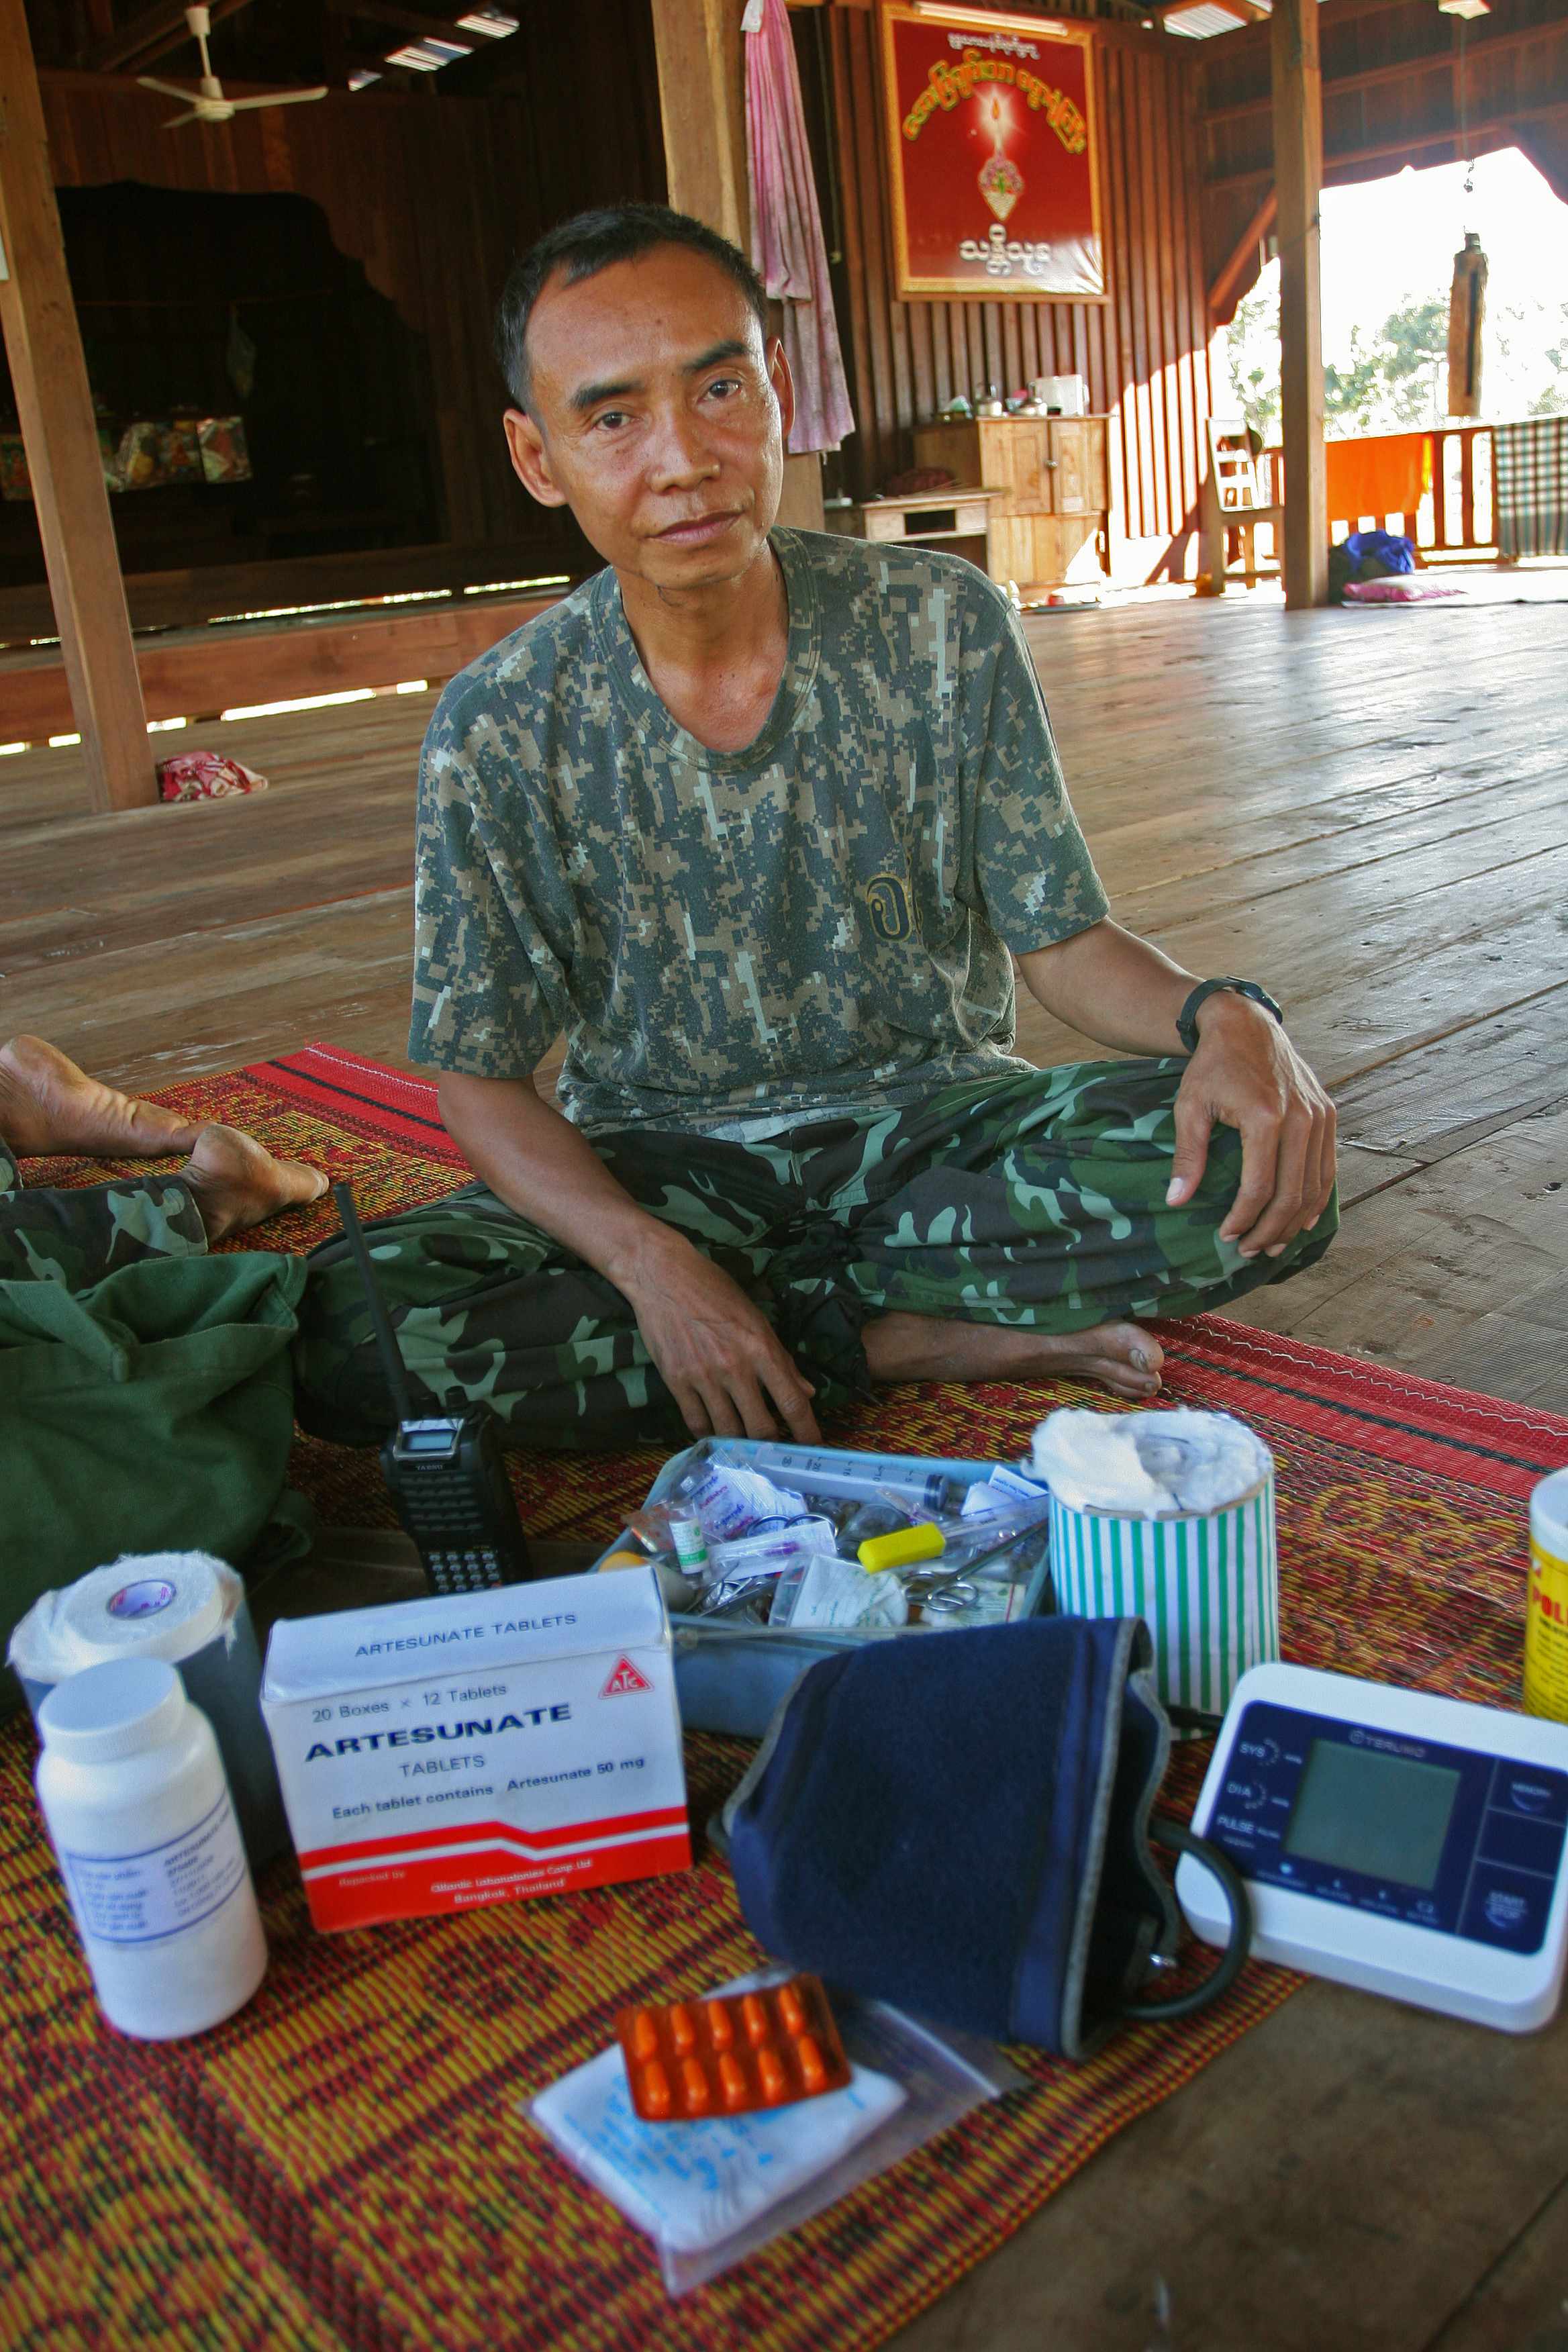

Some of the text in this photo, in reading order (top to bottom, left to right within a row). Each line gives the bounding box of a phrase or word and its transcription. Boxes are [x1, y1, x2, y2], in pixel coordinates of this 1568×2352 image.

[1532, 1585, 1568, 1626] POL
[354, 1614, 576, 1657] ARTESUNATE TABLETS
[312, 1708, 332, 1722] 20
[339, 1701, 390, 1718] Boxes
[423, 1692, 441, 1706] 12
[448, 1683, 507, 1703] Tablets
[305, 1702, 572, 1762] ARTESUNATE
[399, 1754, 485, 1777] TABLETS
[1240, 1743, 1265, 1757] SYS
[332, 1757, 645, 1820] Each tablet contains Artesunate 50 mg
[1227, 1782, 1251, 1797] DIA
[1217, 1816, 1255, 1834] PULSE
[515, 1878, 566, 1895] Thailand
